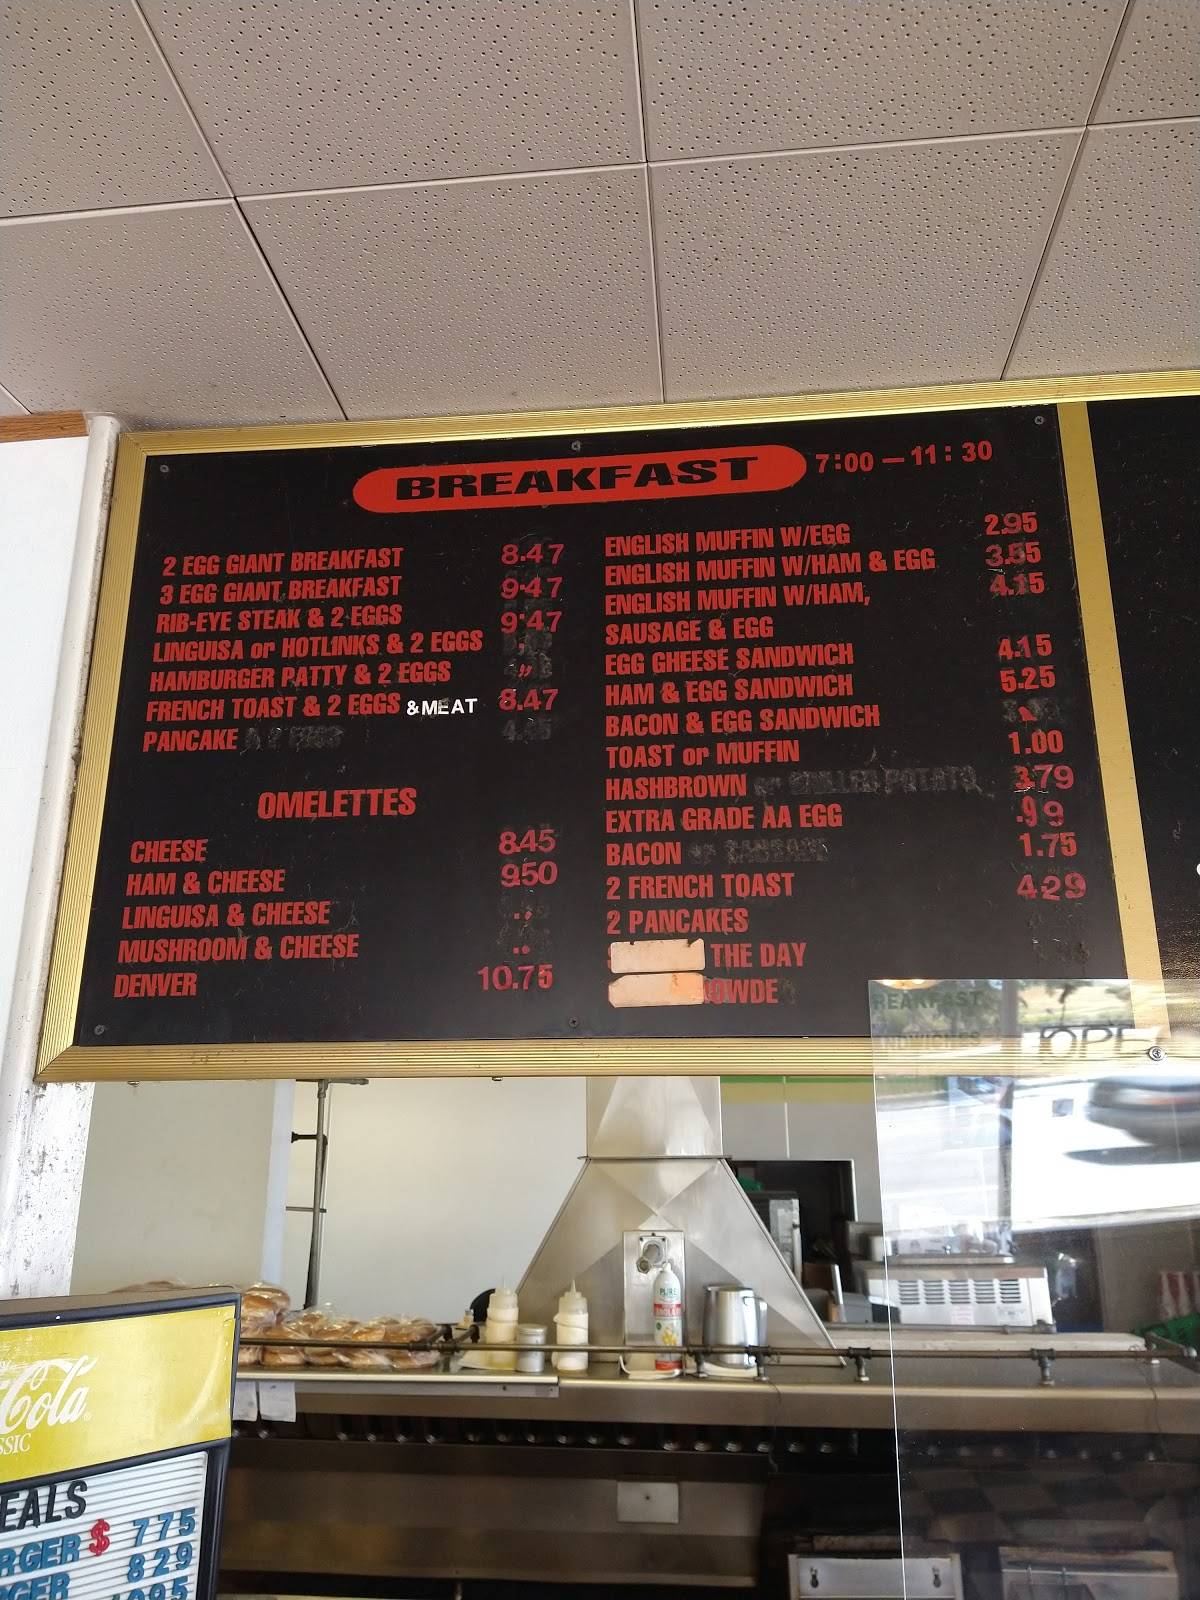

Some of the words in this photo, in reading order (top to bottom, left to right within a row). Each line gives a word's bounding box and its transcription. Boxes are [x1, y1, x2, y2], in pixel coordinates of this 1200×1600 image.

[815, 451, 874, 474] 7:00
[396, 456, 758, 500] BREAKFAST
[984, 512, 1038, 535] 2.95
[500, 543, 565, 565] 8.47
[605, 533, 689, 557] ENGLISH
[696, 527, 774, 552] MUFFIN
[780, 523, 851, 547] W/EGG
[162, 556, 177, 576] 2
[183, 555, 220, 575] EGG
[226, 552, 285, 574] GIANT
[291, 548, 404, 571] BREAKFAST
[605, 561, 690, 586] ENGLISH
[696, 556, 776, 581] MUFFIN
[781, 552, 861, 577] W/HAM
[868, 551, 888, 572] &
[894, 548, 936, 570] EGG
[159, 584, 173, 605] 3
[179, 583, 217, 604] EGG
[223, 581, 283, 602] GIANT
[288, 576, 402, 599] BREAKFAST
[605, 590, 690, 615] ENGLISH
[697, 586, 776, 611] MUFFIN
[783, 582, 870, 606] W/HAM,
[156, 611, 231, 633] RIB-EYE
[237, 608, 300, 631] STEAK
[307, 607, 324, 628] &
[331, 606, 344, 626] 2
[351, 604, 402, 625] EGGS
[605, 620, 701, 645] SAUSAGE
[708, 619, 726, 640] &
[733, 616, 774, 639] EGG
[153, 640, 243, 662] LINGUISA
[250, 642, 275, 659] or
[281, 633, 380, 657] HOTLINKS
[387, 633, 404, 654] &
[410, 632, 424, 653] 2
[431, 630, 483, 651] EGGS
[605, 653, 644, 675] EGG
[736, 643, 854, 670] SANDWICH
[998, 633, 1052, 660] 4.15
[150, 667, 275, 692] HAMBURGER
[281, 665, 347, 688] PATTY
[354, 663, 372, 685] &
[378, 663, 392, 684] 2
[399, 660, 451, 683] EGGS
[605, 683, 654, 706] HAM
[661, 681, 680, 704] &
[687, 679, 727, 703] EGG
[735, 674, 853, 700] SANDWICH
[1000, 665, 1056, 692] 5.25
[146, 699, 224, 722] FRENCH
[232, 696, 297, 719] TOAST
[303, 695, 320, 717] &
[328, 694, 341, 716] 2
[348, 692, 401, 717] EGGS
[499, 688, 559, 711] 8.47
[605, 713, 679, 737] BACON
[685, 712, 704, 734] &
[711, 709, 752, 733] EGG
[760, 704, 880, 731] SANDWICH
[143, 728, 239, 752] PANCAKE
[606, 745, 675, 769] TOAST
[683, 748, 710, 765] or
[716, 740, 799, 764] MUFFIN
[1008, 729, 1064, 754] 1.00
[606, 774, 747, 800] HASHBROWN
[257, 787, 417, 819] OMELETTES
[606, 808, 676, 833] EXTRA
[683, 806, 754, 831] GRADE
[762, 805, 792, 828] AA
[799, 803, 843, 827] EGG
[130, 838, 208, 864] CHEESE
[606, 841, 682, 867] BACON
[1018, 832, 1078, 857] 1.75
[126, 872, 177, 896] HAM
[183, 871, 201, 894] &
[207, 869, 286, 893] CHEESE
[606, 876, 621, 900] 2
[629, 874, 714, 900] FRENCH
[721, 872, 795, 898] TOAST
[122, 904, 219, 929] LINGUISA
[226, 903, 245, 927] &
[252, 900, 331, 926] CHEESE
[607, 909, 621, 934] 2
[629, 907, 749, 933] PANCAKES
[117, 937, 248, 963] MUSHROOM
[254, 936, 273, 960] &
[279, 933, 359, 959] CHEESE
[710, 943, 752, 967] THE
[760, 942, 807, 967] DAY
[113, 972, 198, 998] DENVER
[477, 964, 553, 991] 10.75
[89, 1519, 110, 1557] $
[133, 1507, 196, 1547] 775
[127, 1541, 192, 1583] 829
